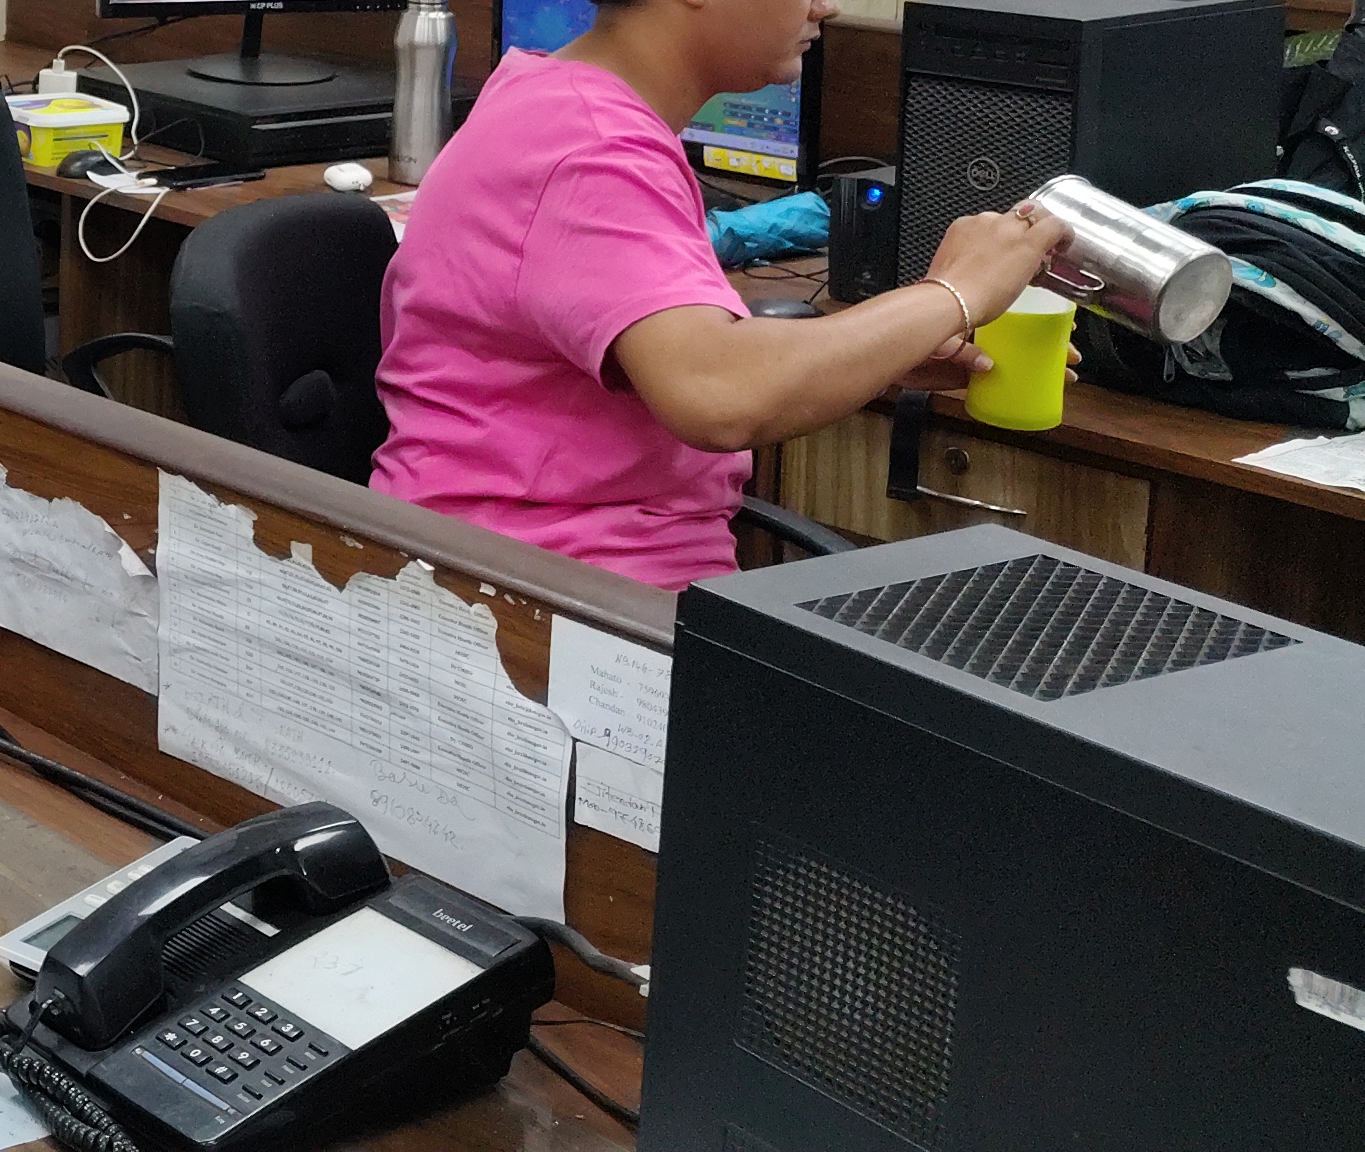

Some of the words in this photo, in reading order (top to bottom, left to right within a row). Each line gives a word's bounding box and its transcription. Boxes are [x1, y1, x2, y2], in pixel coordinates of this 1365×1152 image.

[588, 695, 626, 716] Chandan
[432, 908, 473, 932] beetel
[209, 1007, 221, 1015] 4
[234, 1022, 247, 1030] 5
[260, 1038, 272, 1047] 6
[233, 992, 243, 1000] 1
[255, 1007, 268, 1016] 2
[281, 1023, 294, 1032] 3
[185, 1018, 199, 1027] 7
[211, 1035, 224, 1043] 8
[238, 1051, 250, 1060] 9
[189, 1049, 202, 1057] 0
[214, 1065, 228, 1074] #
